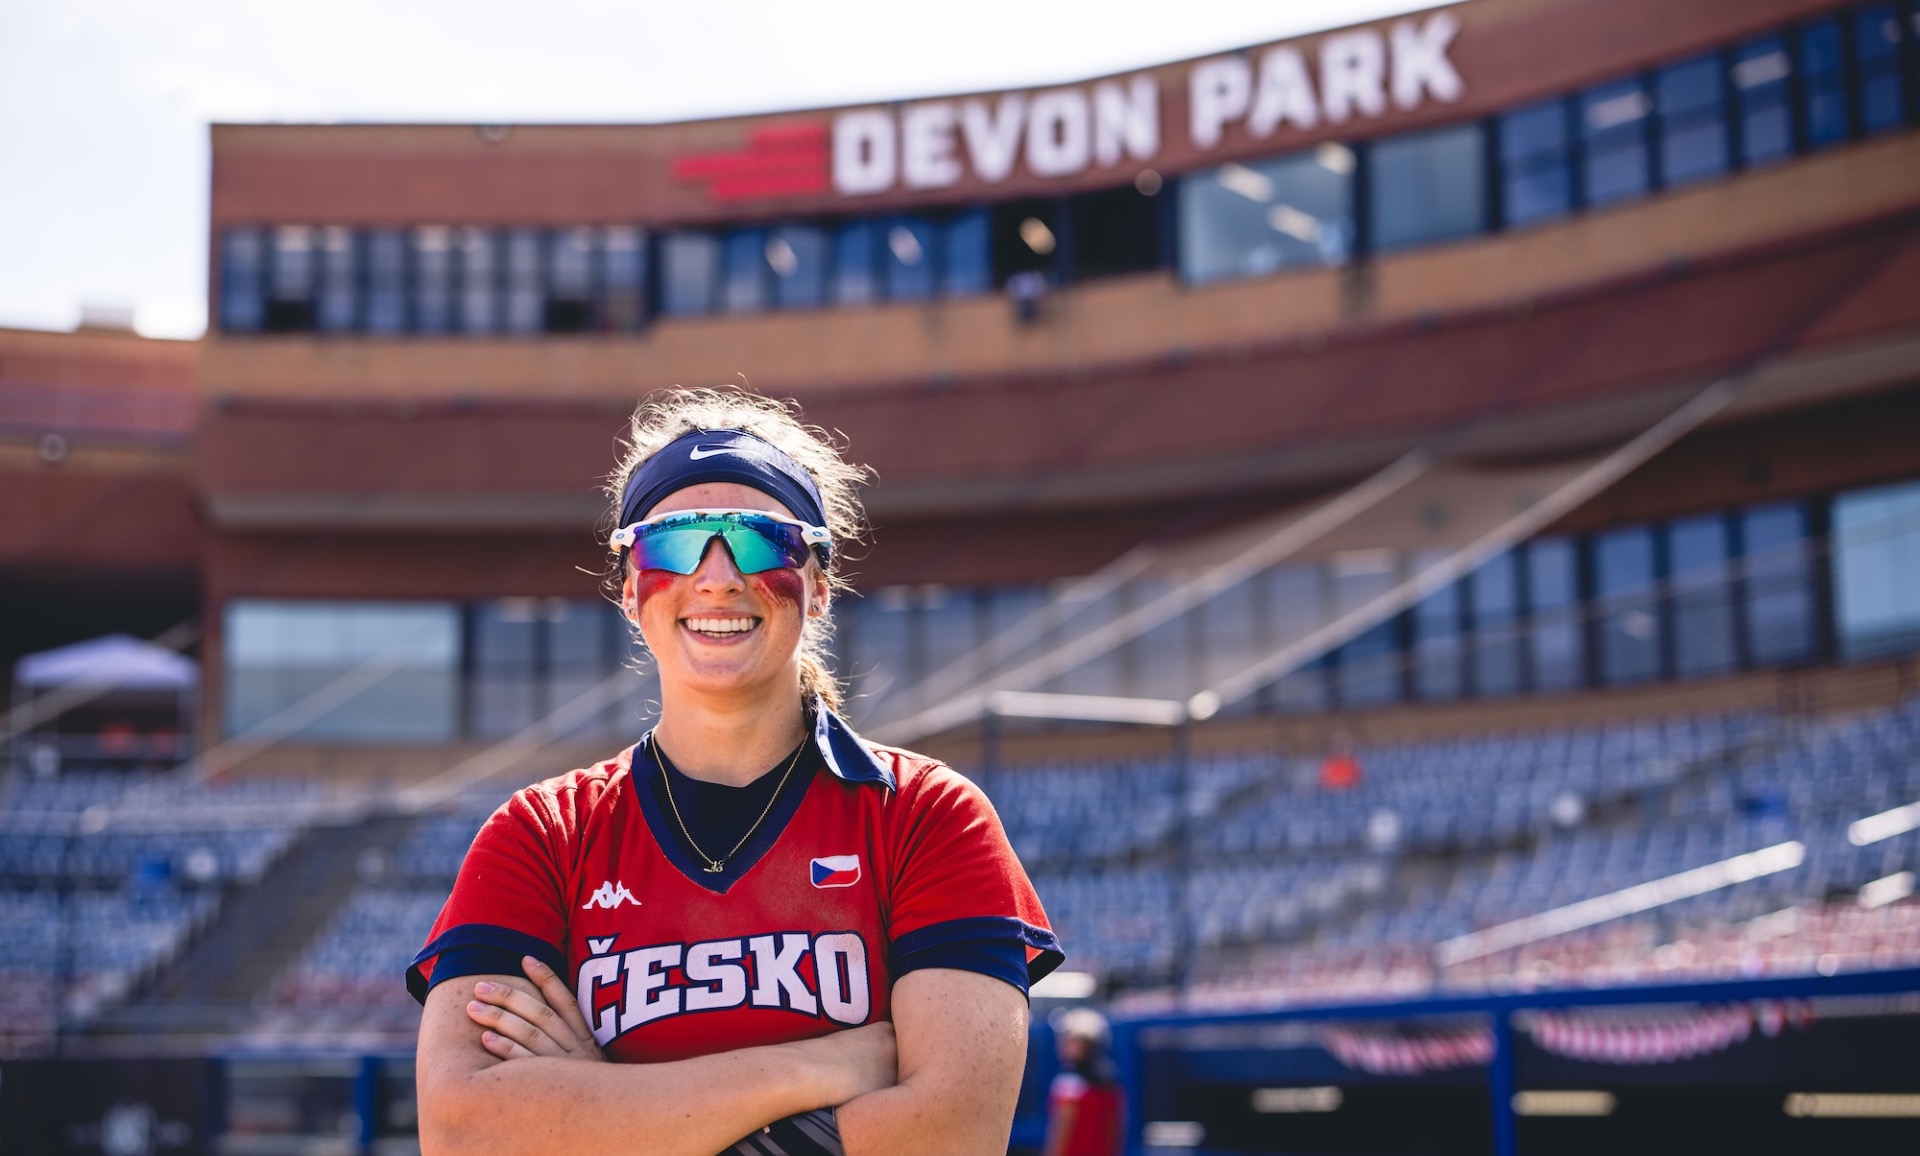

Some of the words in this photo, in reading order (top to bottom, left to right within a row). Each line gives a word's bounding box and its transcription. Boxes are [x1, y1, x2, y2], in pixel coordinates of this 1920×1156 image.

[832, 72, 1159, 194] DEVON
[1189, 11, 1465, 149] PARK
[577, 931, 870, 1048] ČESKO
